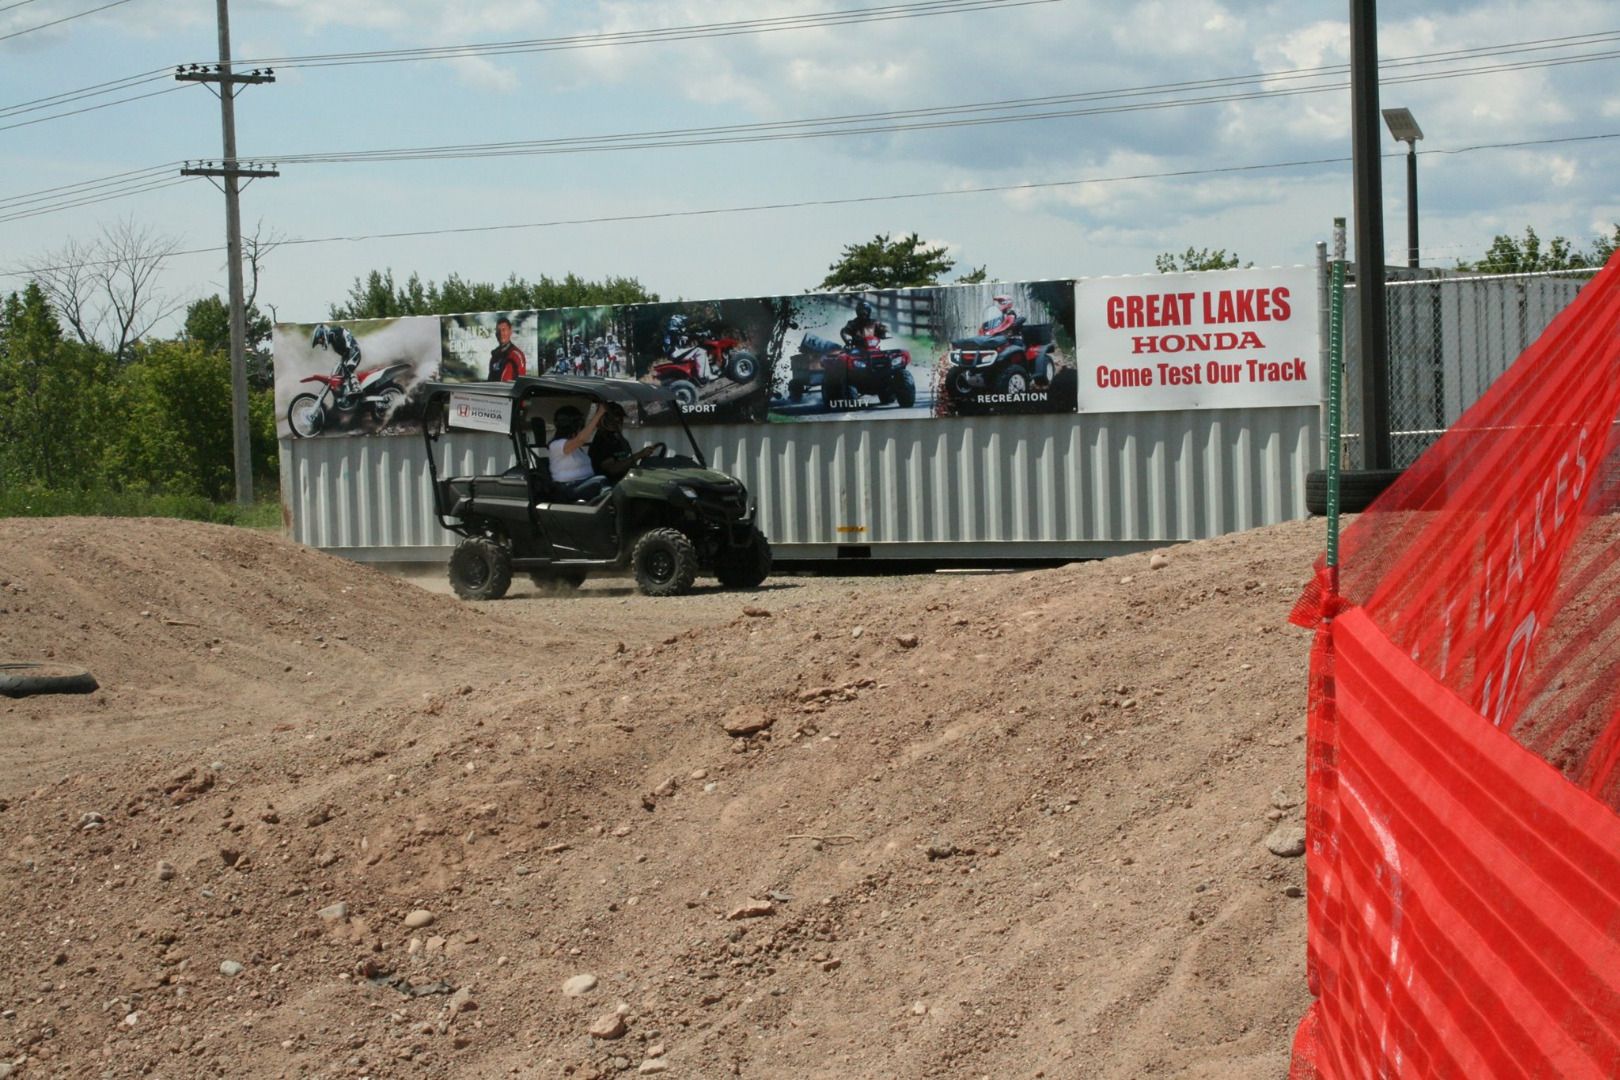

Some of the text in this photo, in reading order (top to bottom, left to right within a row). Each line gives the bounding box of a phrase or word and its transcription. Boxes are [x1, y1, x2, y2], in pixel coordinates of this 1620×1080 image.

[1106, 286, 1291, 330] GREAT LAKES
[1131, 331, 1266, 354] HONDA
[1096, 357, 1307, 388] Come Test Our Track
[829, 399, 870, 408] UTILITY
[977, 391, 1048, 404] RECREATION
[471, 411, 502, 420] HONDA
[681, 404, 717, 414] SPORT
[1484, 427, 1588, 630] LAKES
